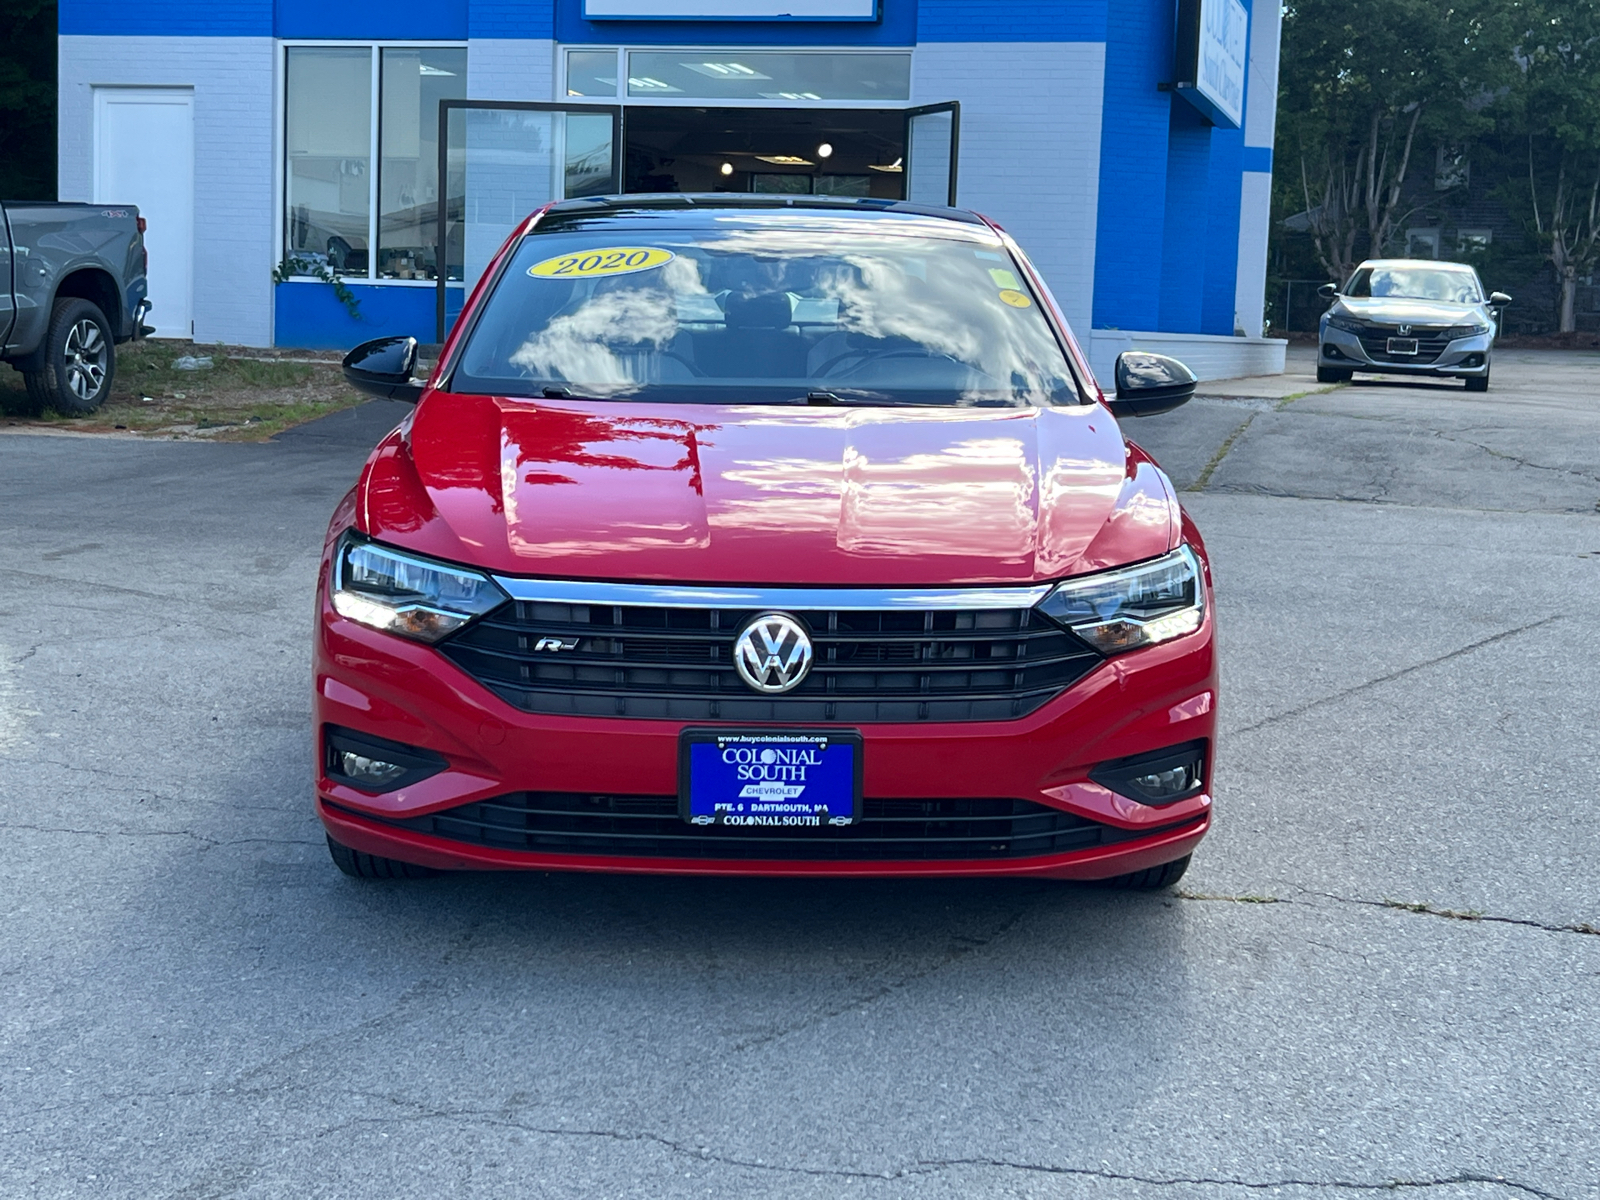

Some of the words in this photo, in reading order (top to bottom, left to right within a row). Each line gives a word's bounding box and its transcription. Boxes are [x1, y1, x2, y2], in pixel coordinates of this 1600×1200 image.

[552, 250, 650, 275] 2020
[717, 735, 828, 744] www.buycolonialsouth.com
[722, 748, 823, 765] COLONIAL
[737, 764, 807, 781] SOUTH
[746, 787, 798, 796] CHEVROLET
[737, 803, 744, 812] 6
[751, 803, 812, 813] DARTMOUTH,
[723, 815, 781, 826] COLONIAL
[782, 815, 820, 826] SOUTH
